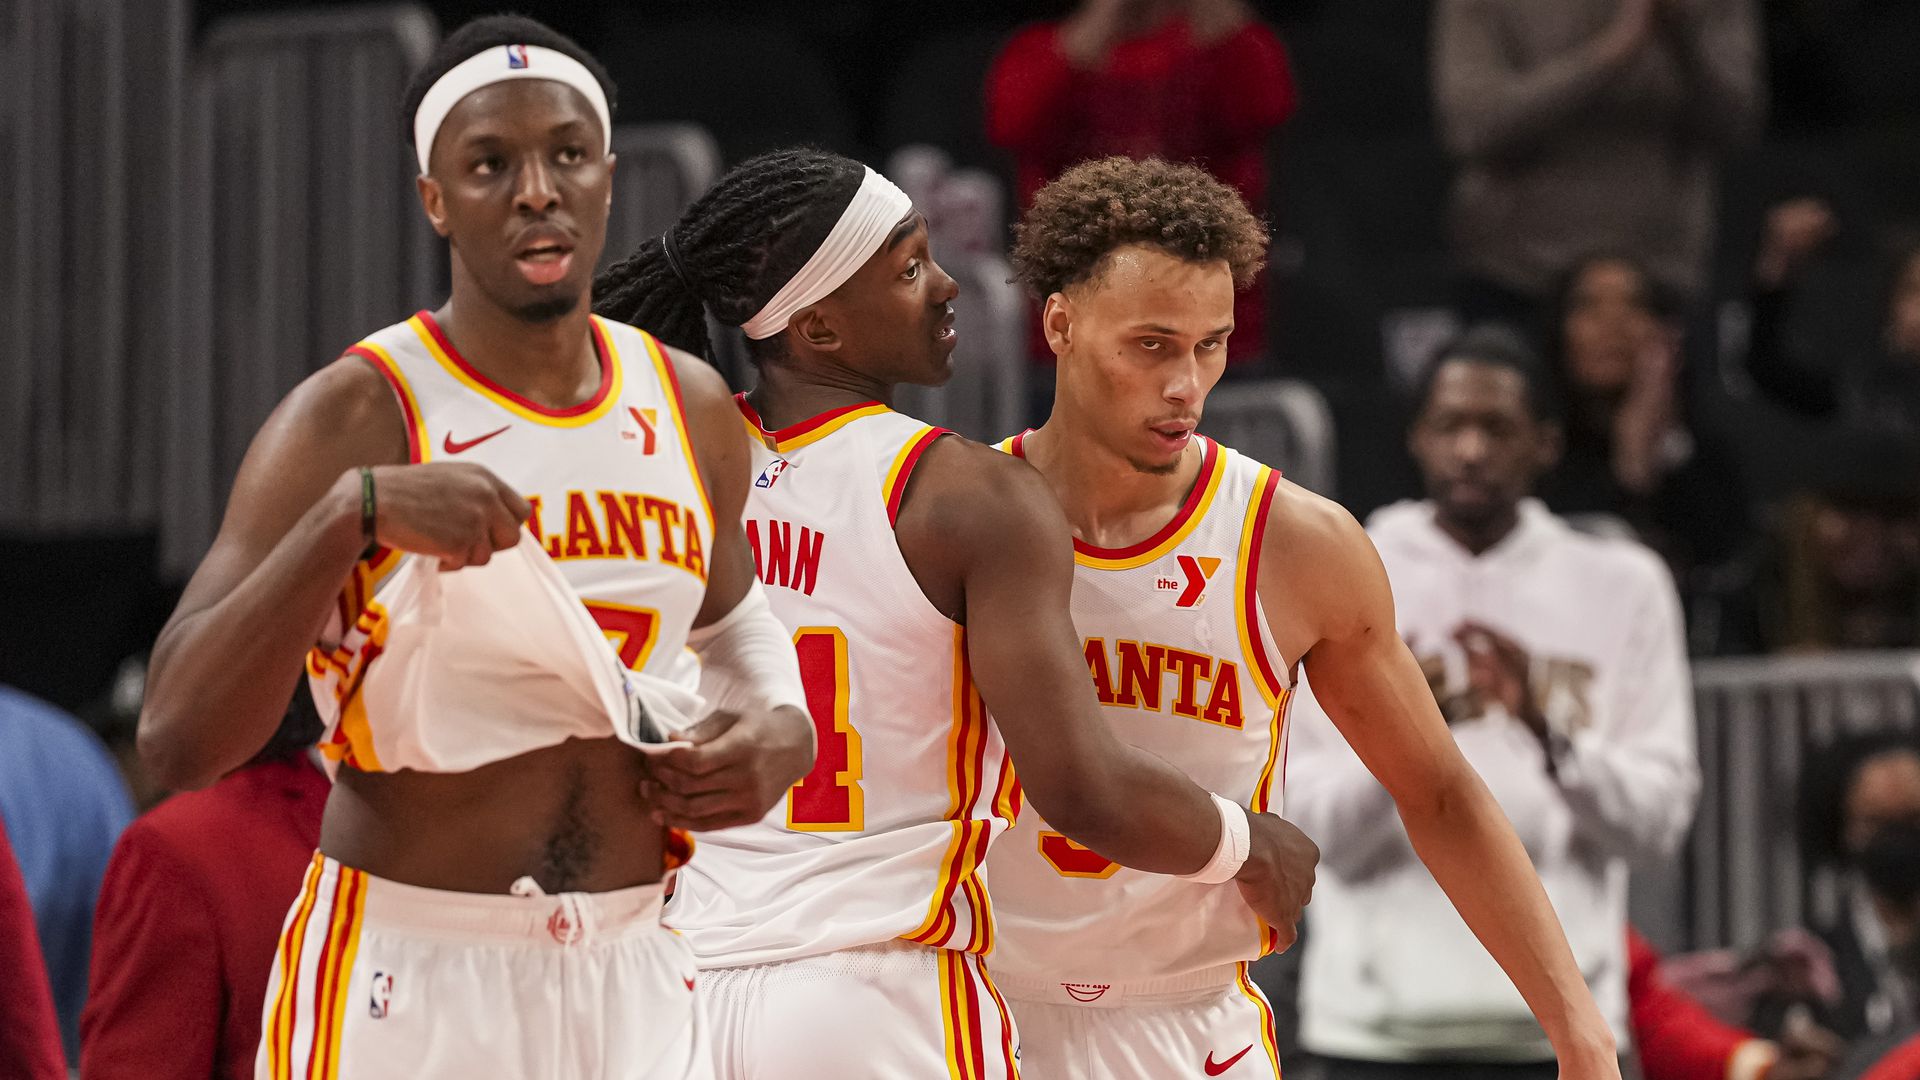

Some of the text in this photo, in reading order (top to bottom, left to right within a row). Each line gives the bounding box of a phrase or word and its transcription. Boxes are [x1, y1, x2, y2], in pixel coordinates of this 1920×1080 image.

[525, 488, 708, 586] LANTA
[746, 519, 824, 597] ANN
[1157, 578, 1178, 590] the
[580, 598, 661, 672] 7
[1083, 637, 1246, 730] ANTA
